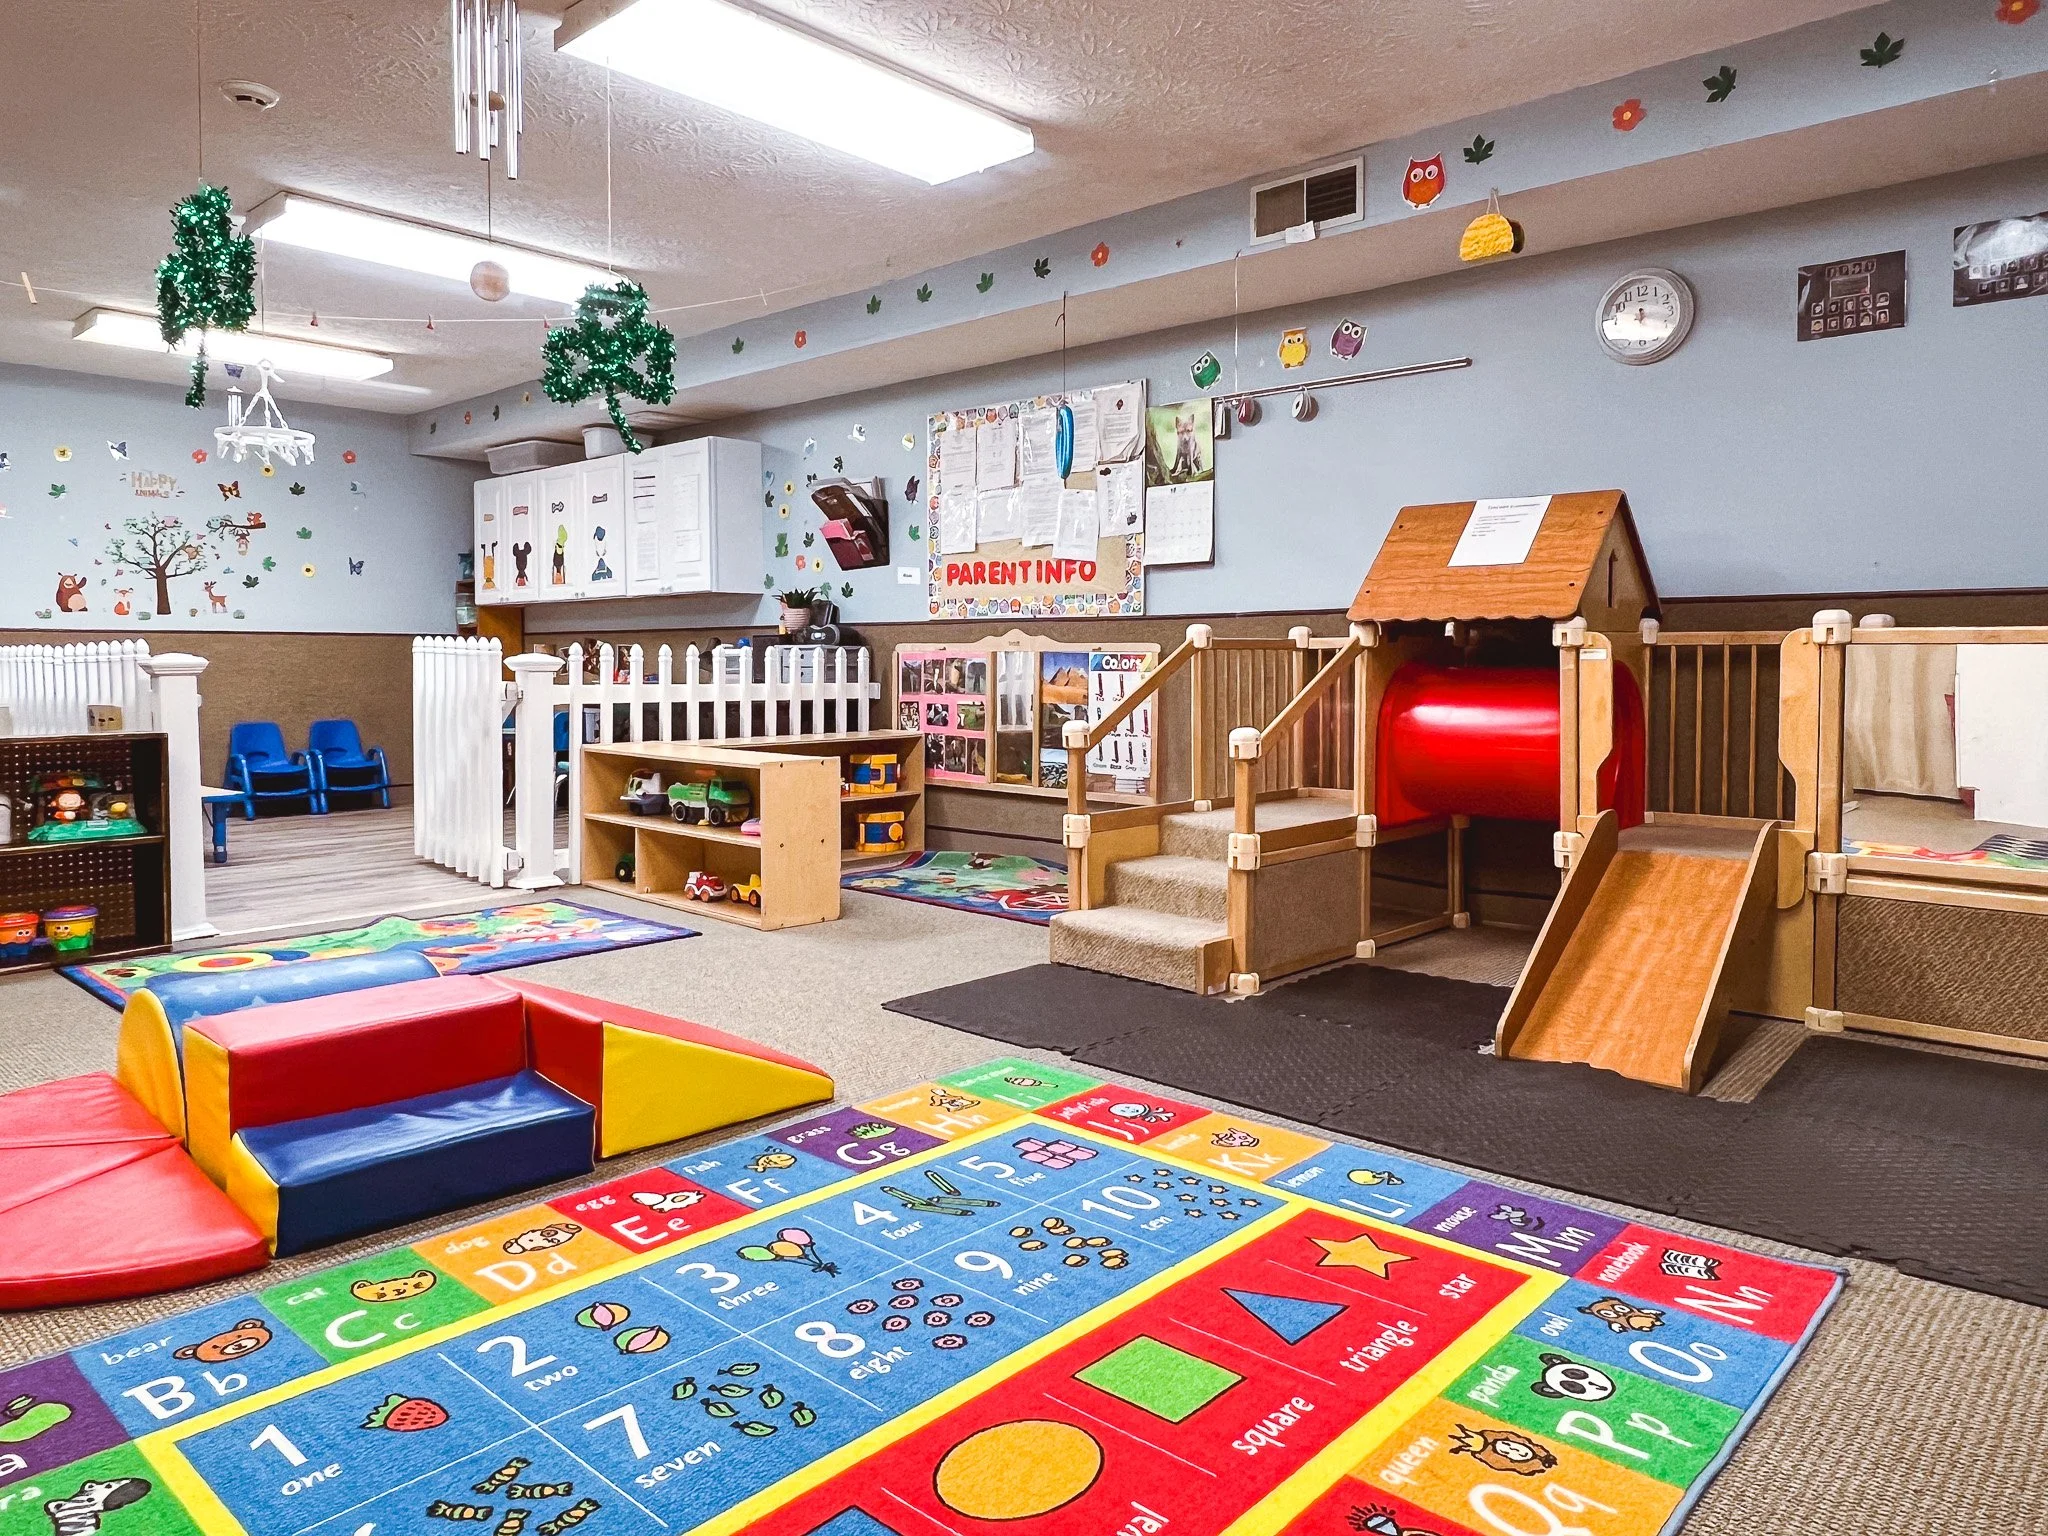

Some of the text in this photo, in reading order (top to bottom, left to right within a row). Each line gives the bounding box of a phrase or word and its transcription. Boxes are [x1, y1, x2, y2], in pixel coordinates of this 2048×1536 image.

[1637, 285, 1649, 297] 12
[1661, 293, 1670, 305] 2
[1615, 301, 1626, 314] 10
[947, 559, 1097, 586] PARENT INFO
[786, 1126, 831, 1144] grass
[836, 1141, 911, 1165] Gg
[682, 1159, 722, 1176] fish
[958, 1155, 1016, 1179] 5
[1009, 1171, 1046, 1187] five
[1275, 1165, 1326, 1189] lemon
[575, 1194, 617, 1211] egg
[853, 1201, 898, 1225] 4
[1082, 1184, 1161, 1221] 10
[881, 1218, 923, 1240] four
[1141, 1213, 1172, 1231] ten
[1434, 1207, 1477, 1232] mouse
[445, 1234, 490, 1256] dog
[955, 1251, 1014, 1280] 9
[1598, 1242, 1649, 1282] notebook
[676, 1263, 740, 1293] 3
[1013, 1273, 1058, 1295] nine
[1439, 1274, 1476, 1299] star
[286, 1286, 328, 1306] cat
[718, 1279, 779, 1310] three
[1540, 1312, 1572, 1336] owl
[101, 1334, 174, 1366] bear
[795, 1322, 865, 1358] 8
[1340, 1321, 1418, 1372] triangle
[477, 1335, 557, 1378] 2
[849, 1344, 913, 1381] eight
[523, 1365, 578, 1391] two
[1467, 1365, 1519, 1407] panda
[582, 1404, 651, 1460] 7
[1232, 1397, 1314, 1455] square
[249, 1424, 308, 1466] 1
[633, 1438, 722, 1489] seven
[1380, 1437, 1439, 1485] queen
[281, 1460, 342, 1496] one
